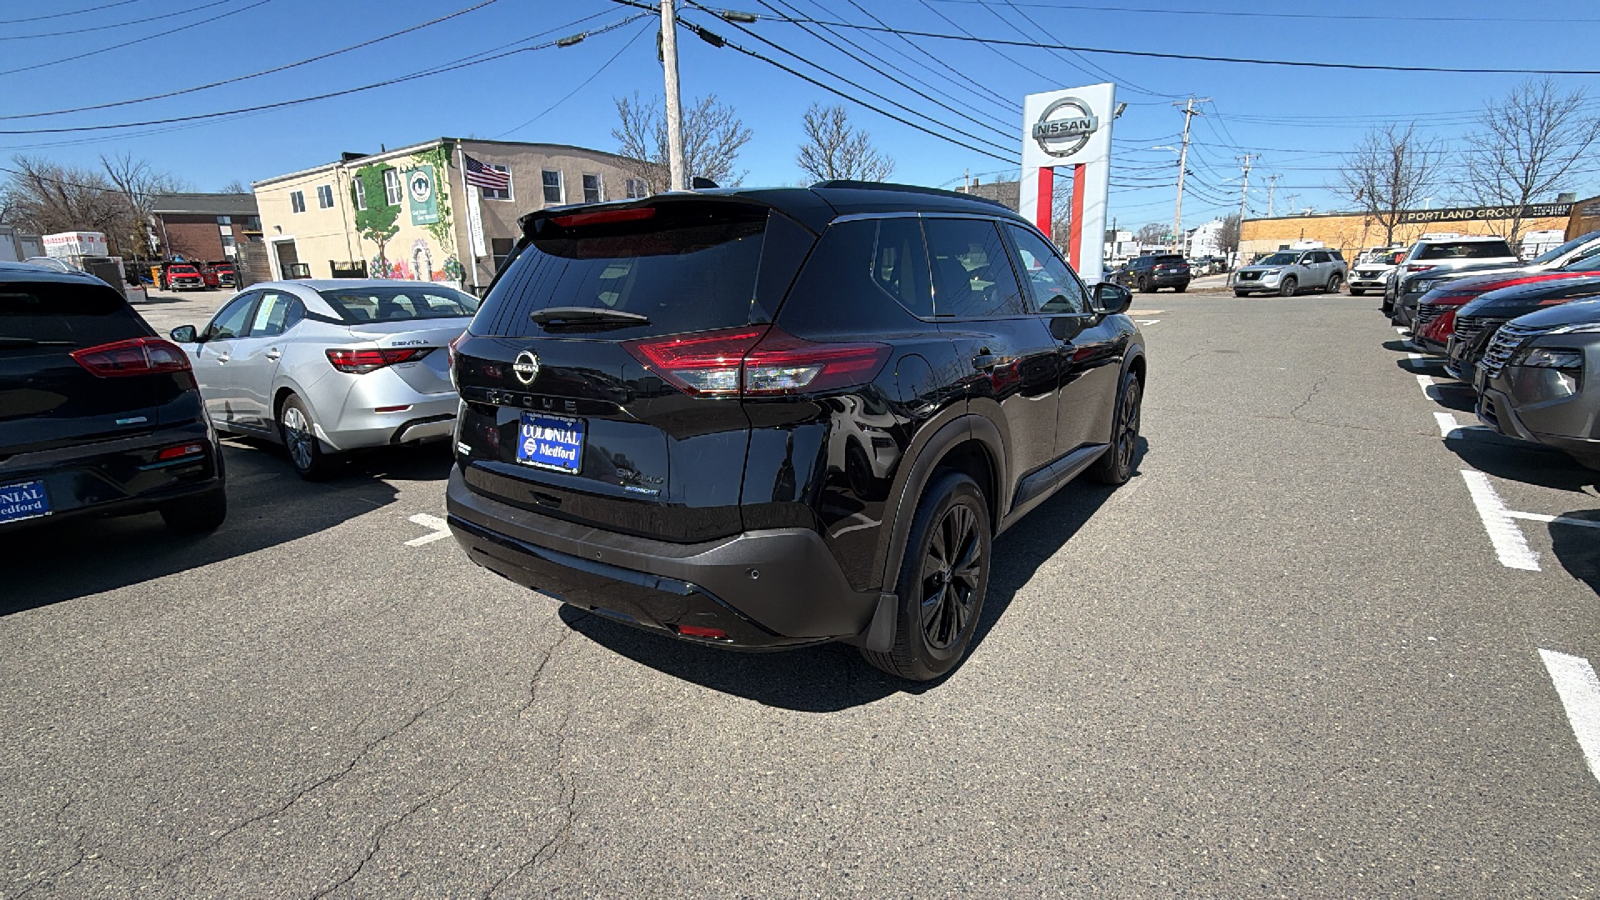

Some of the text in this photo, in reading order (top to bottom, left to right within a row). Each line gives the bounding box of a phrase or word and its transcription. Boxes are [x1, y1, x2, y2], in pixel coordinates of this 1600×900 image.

[1037, 119, 1091, 135] NISSAN
[1407, 209, 1475, 221] PORTLAND
[391, 339, 429, 347] SENTRA
[513, 364, 539, 373] NISSAN
[522, 424, 580, 445] COLONIAL
[540, 442, 576, 461] Medford
[0, 490, 43, 504] NIAL
[0, 500, 42, 515] edford
